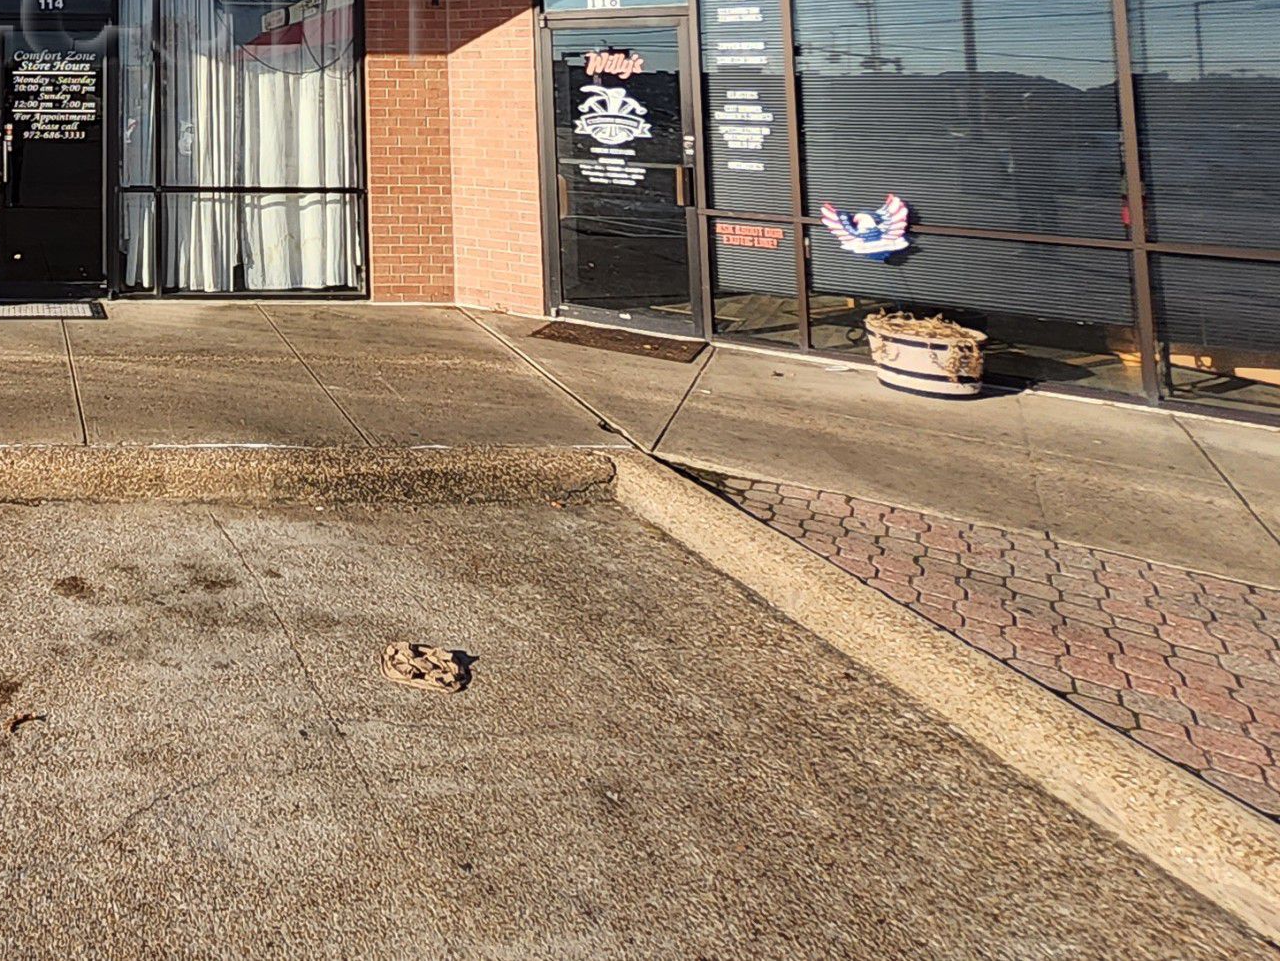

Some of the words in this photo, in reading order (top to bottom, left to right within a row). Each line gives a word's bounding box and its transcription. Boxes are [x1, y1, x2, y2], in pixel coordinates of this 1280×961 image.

[13, 50, 62, 63] Comfort
[65, 50, 97, 61] Zone
[19, 61, 52, 71] Store
[53, 61, 92, 71] Hours
[585, 51, 644, 80] Willy's
[13, 76, 51, 85] Monday
[56, 76, 97, 85] Saturday
[60, 85, 81, 93] 9:00
[81, 86, 96, 94] pm
[38, 93, 71, 102] Sunday
[13, 100, 38, 108] 12:00
[40, 102, 53, 110] pm
[60, 100, 81, 108] 7:00
[81, 102, 96, 110] pm
[13, 113, 30, 121] For
[31, 114, 96, 124] Appointments
[31, 122, 59, 130] Please
[61, 122, 78, 130] call
